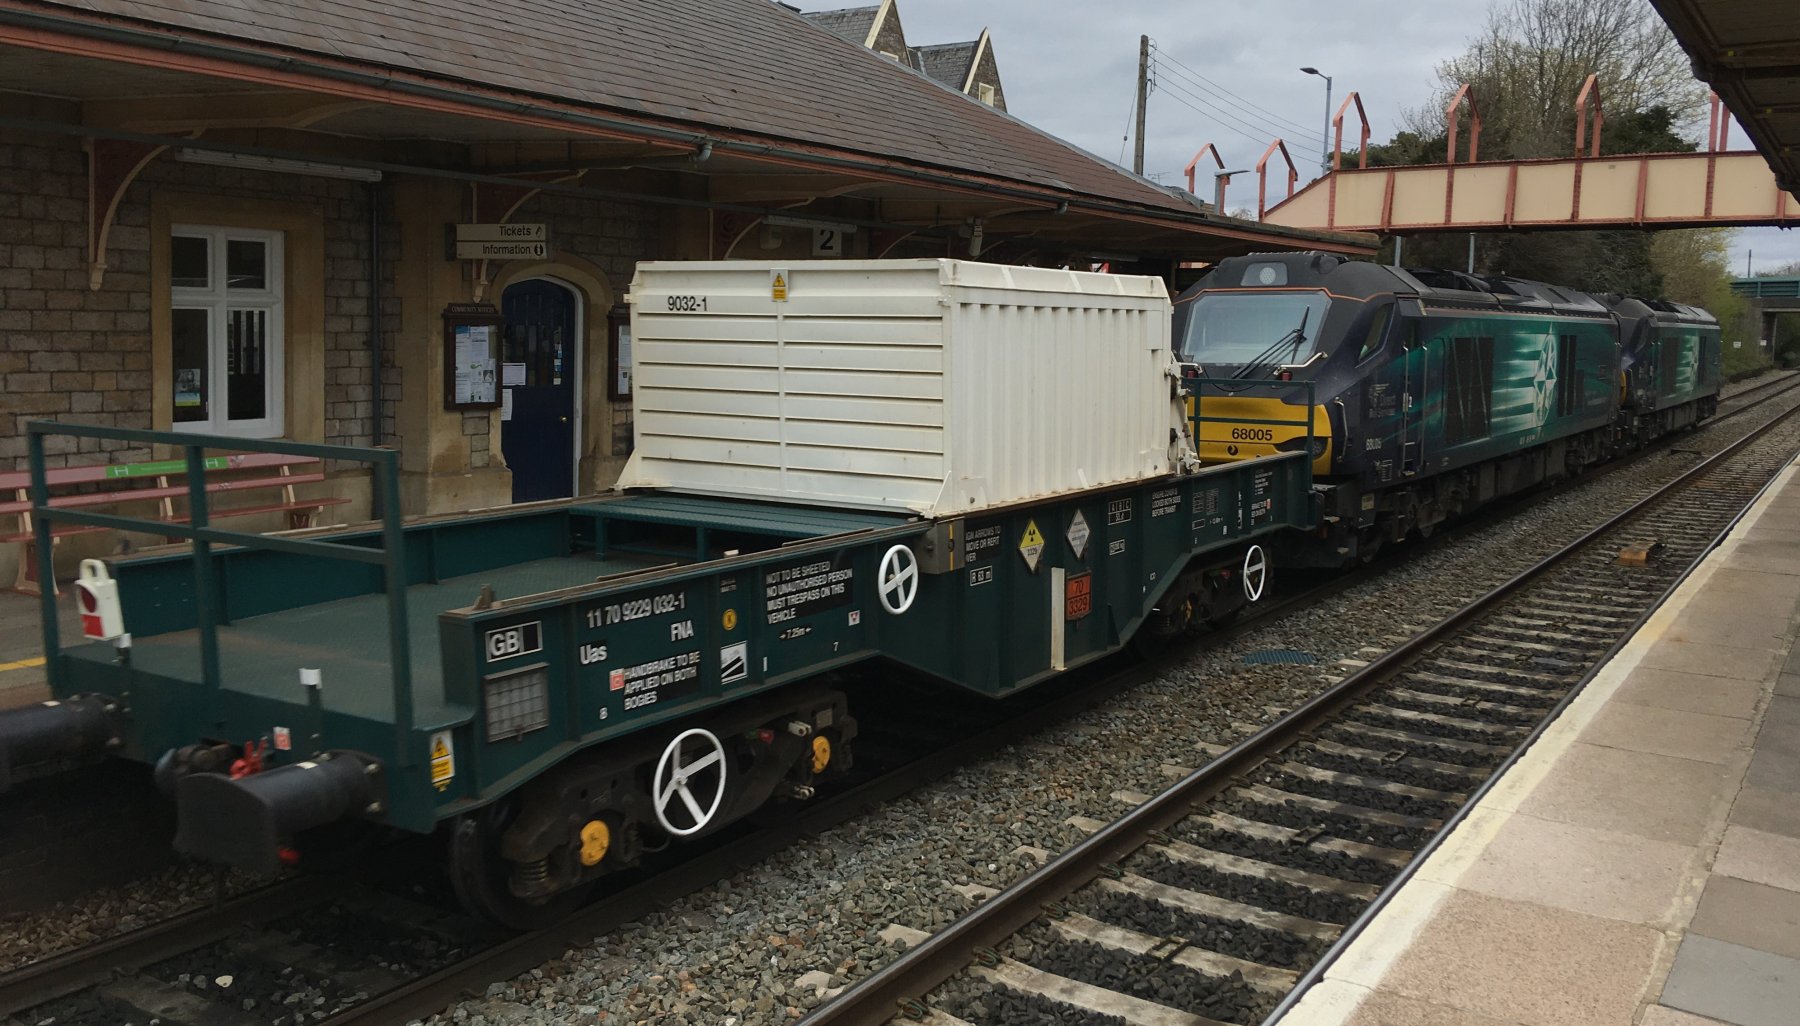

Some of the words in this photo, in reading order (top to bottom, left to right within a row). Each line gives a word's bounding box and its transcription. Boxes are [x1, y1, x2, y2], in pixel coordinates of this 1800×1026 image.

[499, 225, 532, 237] Tickets
[820, 229, 834, 251] 2
[482, 243, 531, 256] Information
[667, 295, 708, 312] 9032-1
[1231, 427, 1273, 441] 68005
[766, 571, 781, 585] NOT
[781, 569, 791, 581] TO
[791, 567, 802, 579] BE
[802, 561, 831, 577] SHEETED
[766, 585, 778, 598] NO
[778, 574, 828, 596] UNAUTHORISED
[827, 568, 853, 584] PERSON
[767, 597, 786, 612] MUST
[786, 588, 820, 606] TRESPASS
[820, 586, 831, 598] ON
[830, 583, 845, 595] THIS
[1074, 580, 1084, 594] 70
[586, 608, 602, 629] 11
[604, 604, 621, 625] 70
[621, 598, 653, 621] 9229
[652, 592, 685, 615] 032-1
[767, 607, 797, 625] VEHICLE
[1069, 596, 1088, 616] 3329
[670, 620, 694, 642] FNA
[489, 630, 519, 656] GB
[579, 644, 608, 665] Uas
[624, 657, 676, 681] HANDBRAKE
[676, 654, 689, 667] TO
[688, 650, 701, 665] BE
[624, 675, 660, 696] APPLIED
[660, 671, 674, 686] ON
[674, 665, 697, 682] BOTH
[624, 690, 658, 711] BOGIES
